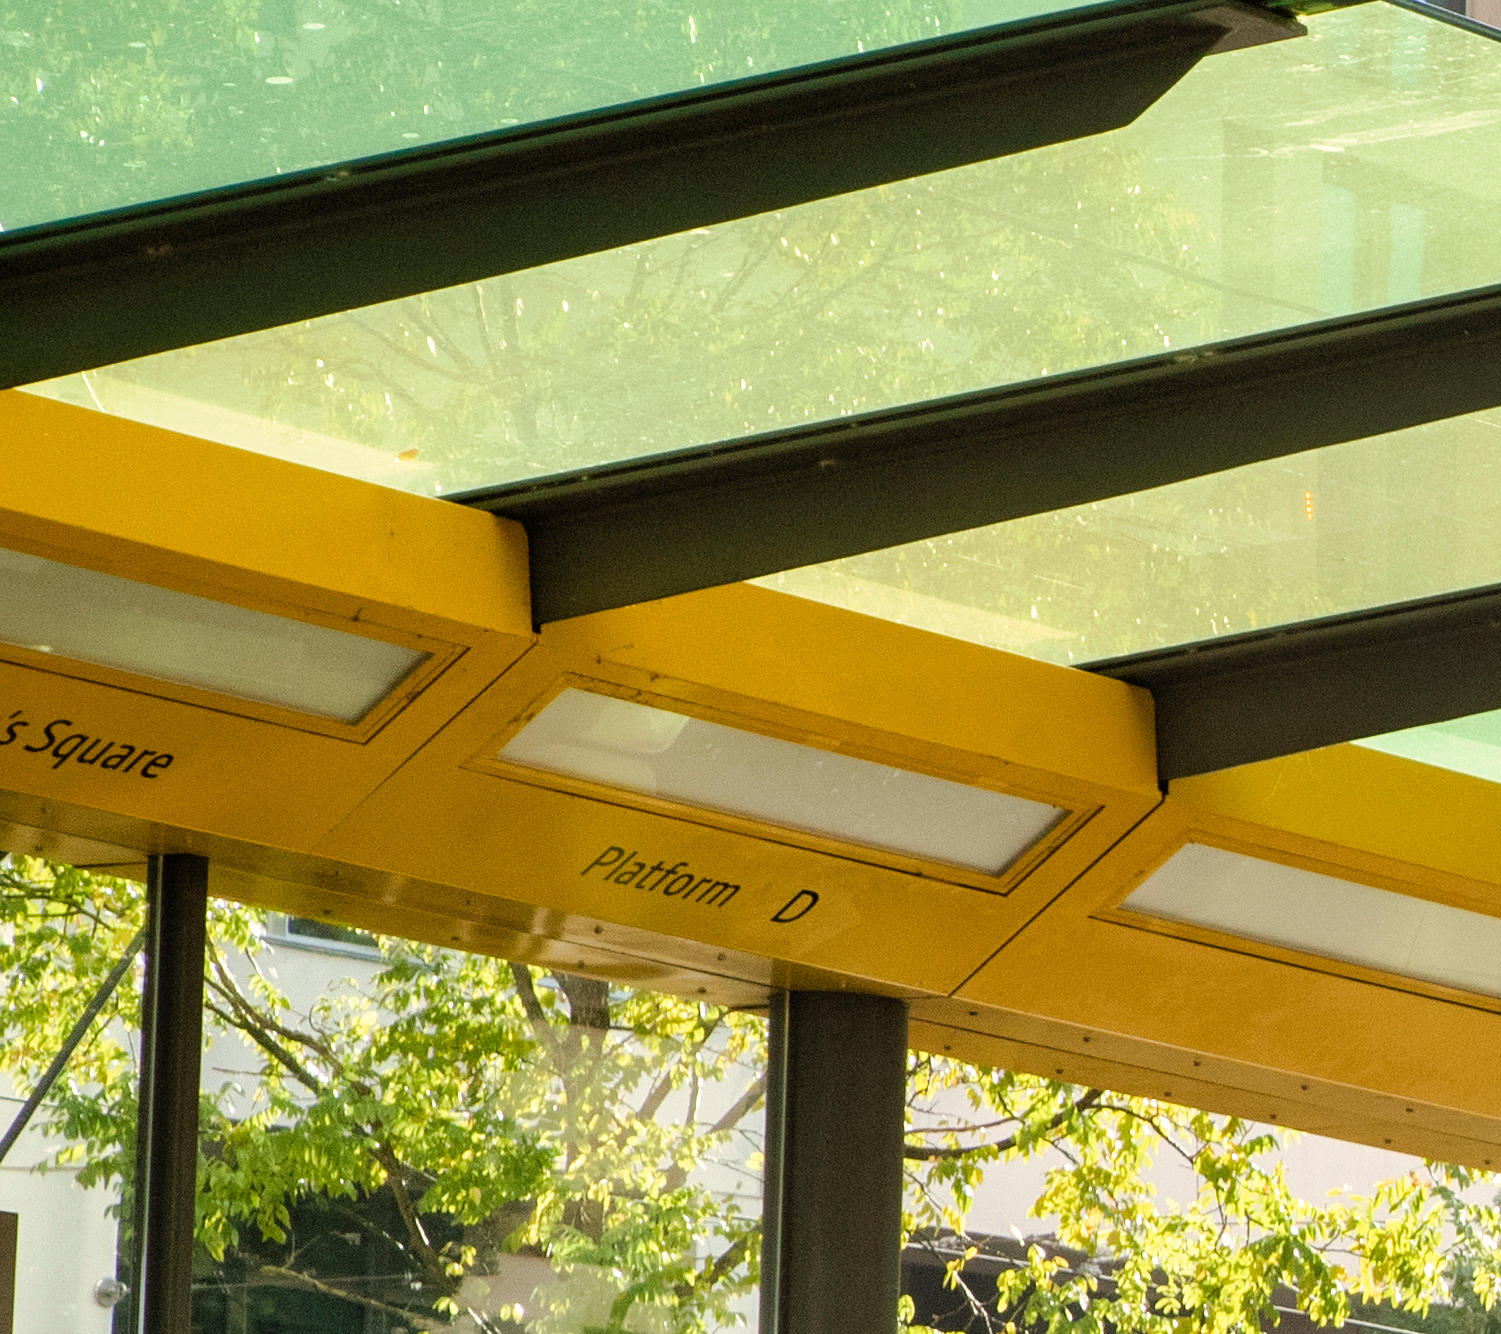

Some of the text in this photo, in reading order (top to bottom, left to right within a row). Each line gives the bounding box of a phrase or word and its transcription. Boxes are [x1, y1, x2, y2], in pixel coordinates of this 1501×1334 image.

[23, 719, 175, 779] Square
[580, 845, 820, 924] Platform D
